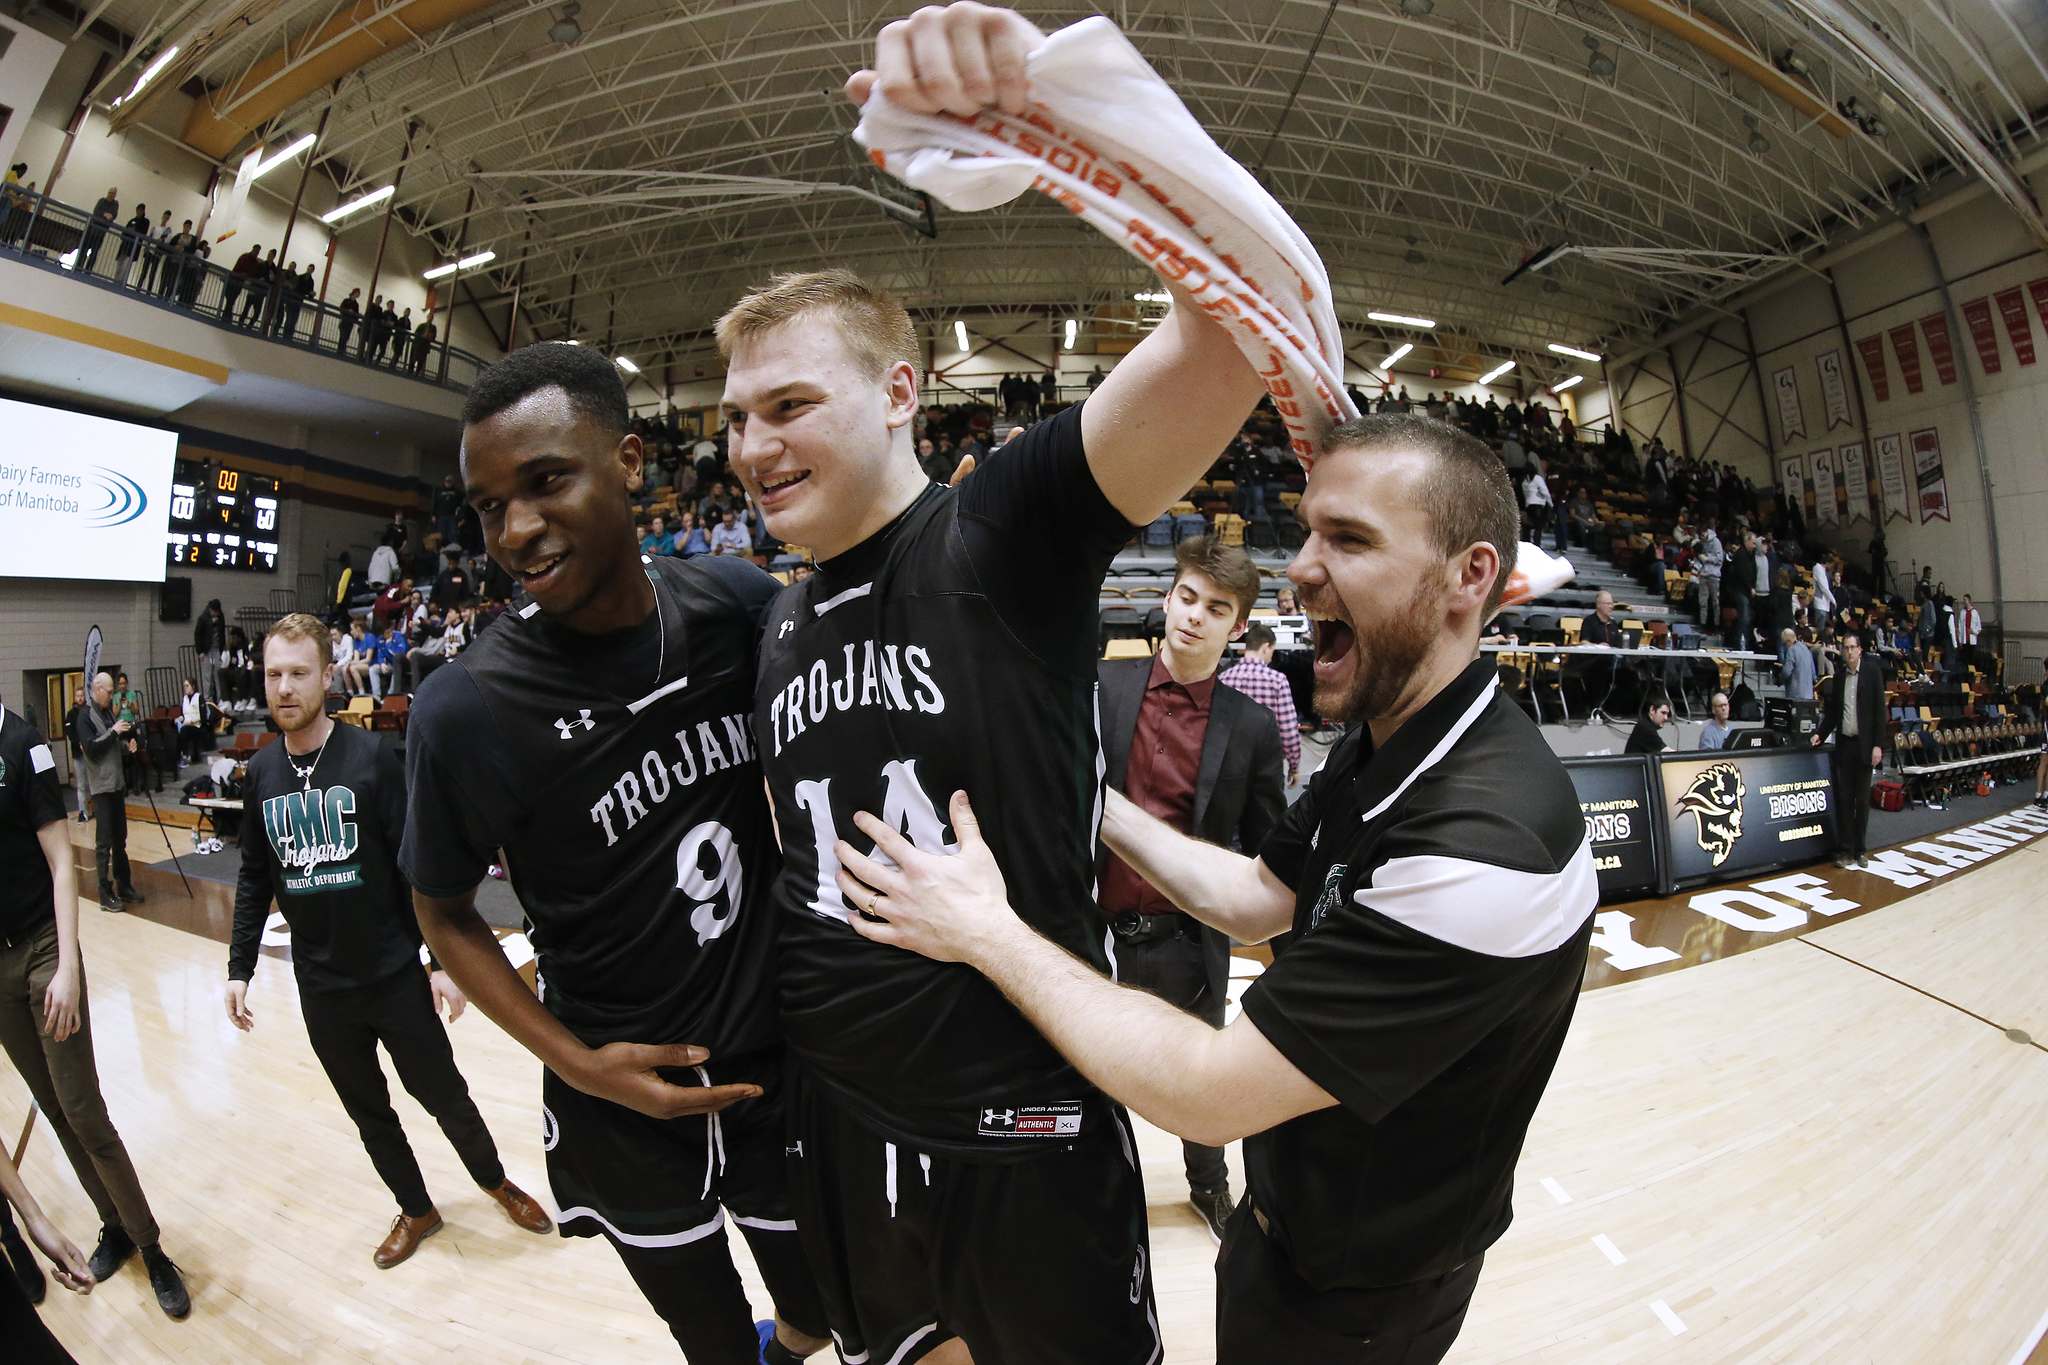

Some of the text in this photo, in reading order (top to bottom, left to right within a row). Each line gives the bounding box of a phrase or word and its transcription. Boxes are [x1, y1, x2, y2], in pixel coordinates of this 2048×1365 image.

[0, 463, 82, 488] airy Farmers
[0, 489, 79, 513] of Manitoba
[222, 509, 230, 523] 4
[190, 546, 199, 562] 2
[770, 638, 946, 758] TROJANS
[1759, 779, 1830, 794] UNIVERSITY OF MANITOBA
[1590, 799, 1639, 812] MANITOBA
[1768, 790, 1827, 819] BISONS
[262, 785, 358, 863] UMC
[794, 759, 962, 925] 14
[278, 836, 352, 878] Trojans
[286, 878, 314, 889] ATHLETIC
[675, 820, 744, 948] 9
[1688, 873, 1861, 933] OF
[1018, 1120, 1054, 1129] AUTHENTIC
